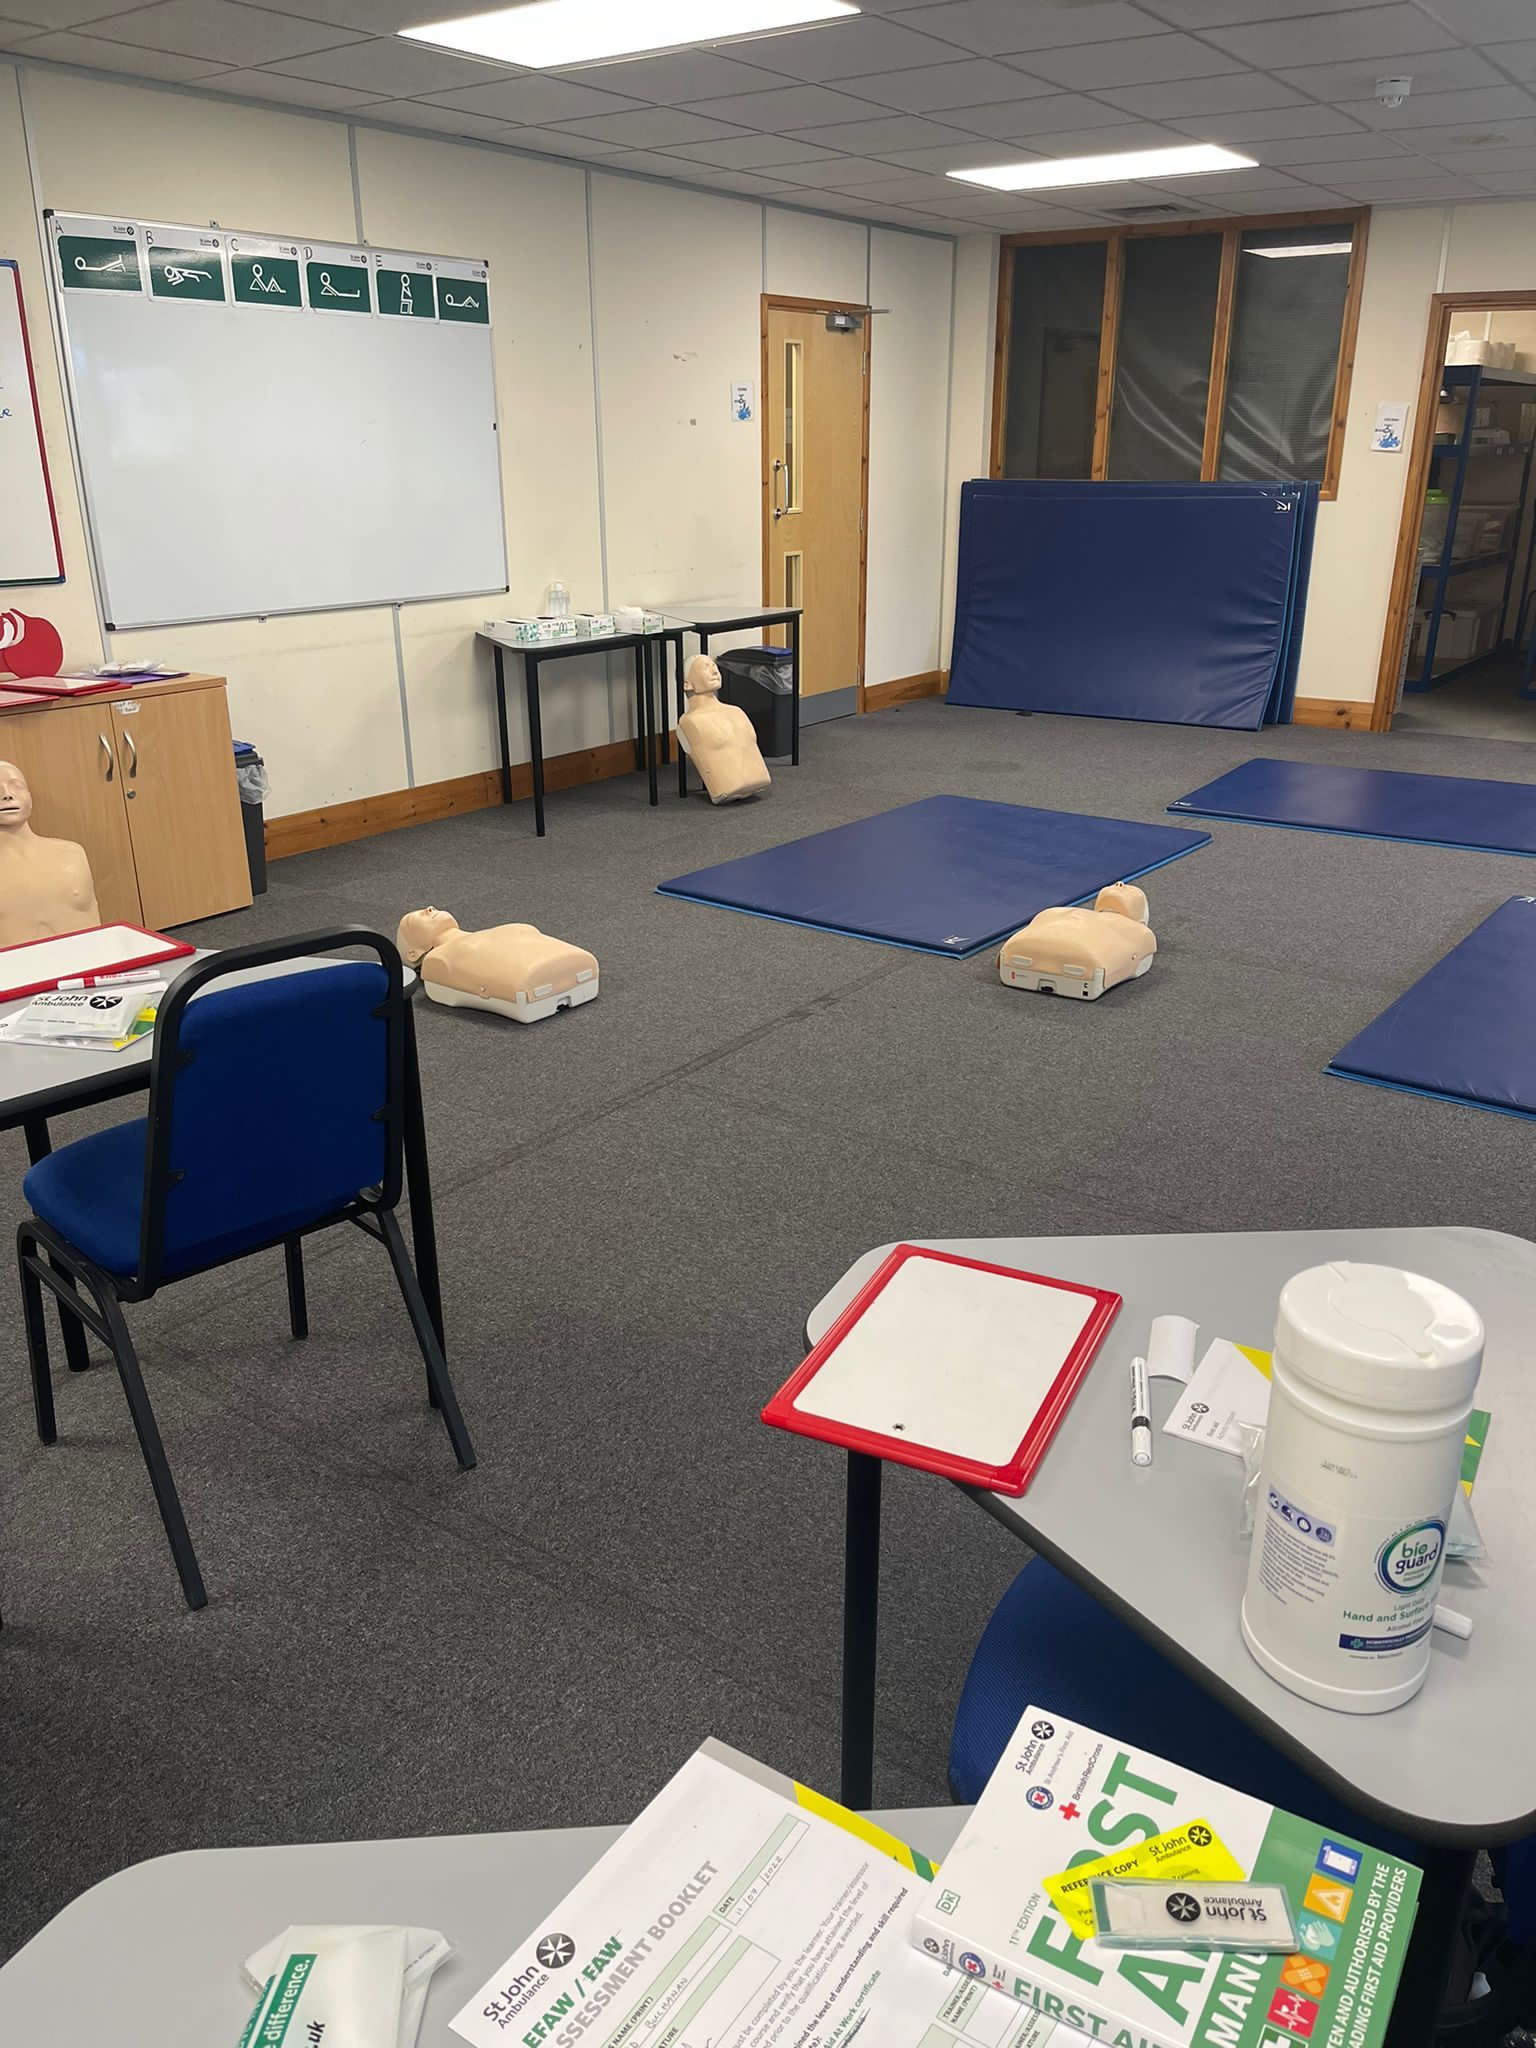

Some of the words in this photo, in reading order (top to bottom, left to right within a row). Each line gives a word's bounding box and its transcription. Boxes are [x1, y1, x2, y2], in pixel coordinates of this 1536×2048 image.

[55, 219, 64, 234] A
[145, 230, 154, 245] B
[230, 238, 240, 251] C
[303, 246, 313, 260] D
[375, 254, 383, 267] E
[1394, 1542, 1439, 1575] guard
[1401, 1542, 1429, 1559] bio
[1343, 1610, 1374, 1622] Hand
[1376, 1613, 1397, 1622] and
[1015, 1761, 1028, 1773] St
[1022, 1739, 1038, 1766] John
[1026, 1743, 1045, 1776] Ambulance
[1072, 1743, 1104, 1801] BritishRedCross
[1148, 1844, 1163, 1857] St
[1164, 1835, 1187, 1855] John
[1026, 1752, 1178, 1986] FST
[1113, 1858, 1140, 1877] COPY
[1373, 1862, 1390, 1890] THE
[718, 1896, 736, 1914] DATE
[1016, 1892, 1041, 1929] EDITION
[1203, 1895, 1263, 1908] Ambulance
[1205, 1905, 1246, 1922] John
[1249, 1907, 1268, 1922] St
[1367, 1887, 1382, 1909] BY
[1378, 1867, 1408, 1943] PROVIDERS
[556, 1938, 653, 2048] SSESSMENT
[647, 1860, 718, 1941] BOOKLET
[750, 2023, 770, 2048] course
[768, 2008, 781, 2025] and
[779, 1990, 796, 2010] verify
[792, 1975, 806, 1990] that
[811, 1945, 826, 1963] have
[825, 1915, 846, 1946] attained
[842, 1905, 854, 1918] the
[849, 1888, 864, 1906] level
[751, 1990, 781, 2027] completed
[776, 1980, 788, 1995] by
[794, 1953, 807, 1967] the
[820, 1911, 835, 1928] Your
[806, 2018, 820, 2032] the
[815, 2000, 832, 2020] level
[828, 1992, 838, 2002] of
[834, 1939, 873, 1993] understanding
[869, 1927, 881, 1943] and
[877, 1913, 891, 1929] skill
[887, 1887, 909, 1916] required
[1344, 1909, 1377, 1995] AUTHORISED
[1372, 1942, 1390, 1974] AID
[483, 2000, 507, 2022] St
[500, 1965, 540, 2005] John
[522, 1992, 575, 2048] EFAW
[581, 1936, 623, 1981] FAW
[769, 2022, 785, 2043] prior
[788, 2004, 801, 2017] the
[798, 1962, 830, 2004] qualification
[825, 1940, 844, 1963] being
[841, 1912, 864, 1944] awarded.
[1360, 1971, 1382, 2006] FIRST
[263, 1959, 311, 2041] difference.
[497, 1973, 550, 2029] Ambulance
[833, 2026, 844, 2039] At
[840, 2006, 857, 2027] Work
[854, 1969, 882, 2009] certificate
[1014, 1977, 1108, 2036] FIRST
[1334, 1994, 1354, 2027] AND
[613, 2022, 633, 2047] NAME
[631, 1995, 655, 2025] (PRINT)
[1347, 2005, 1372, 2048] ADING
